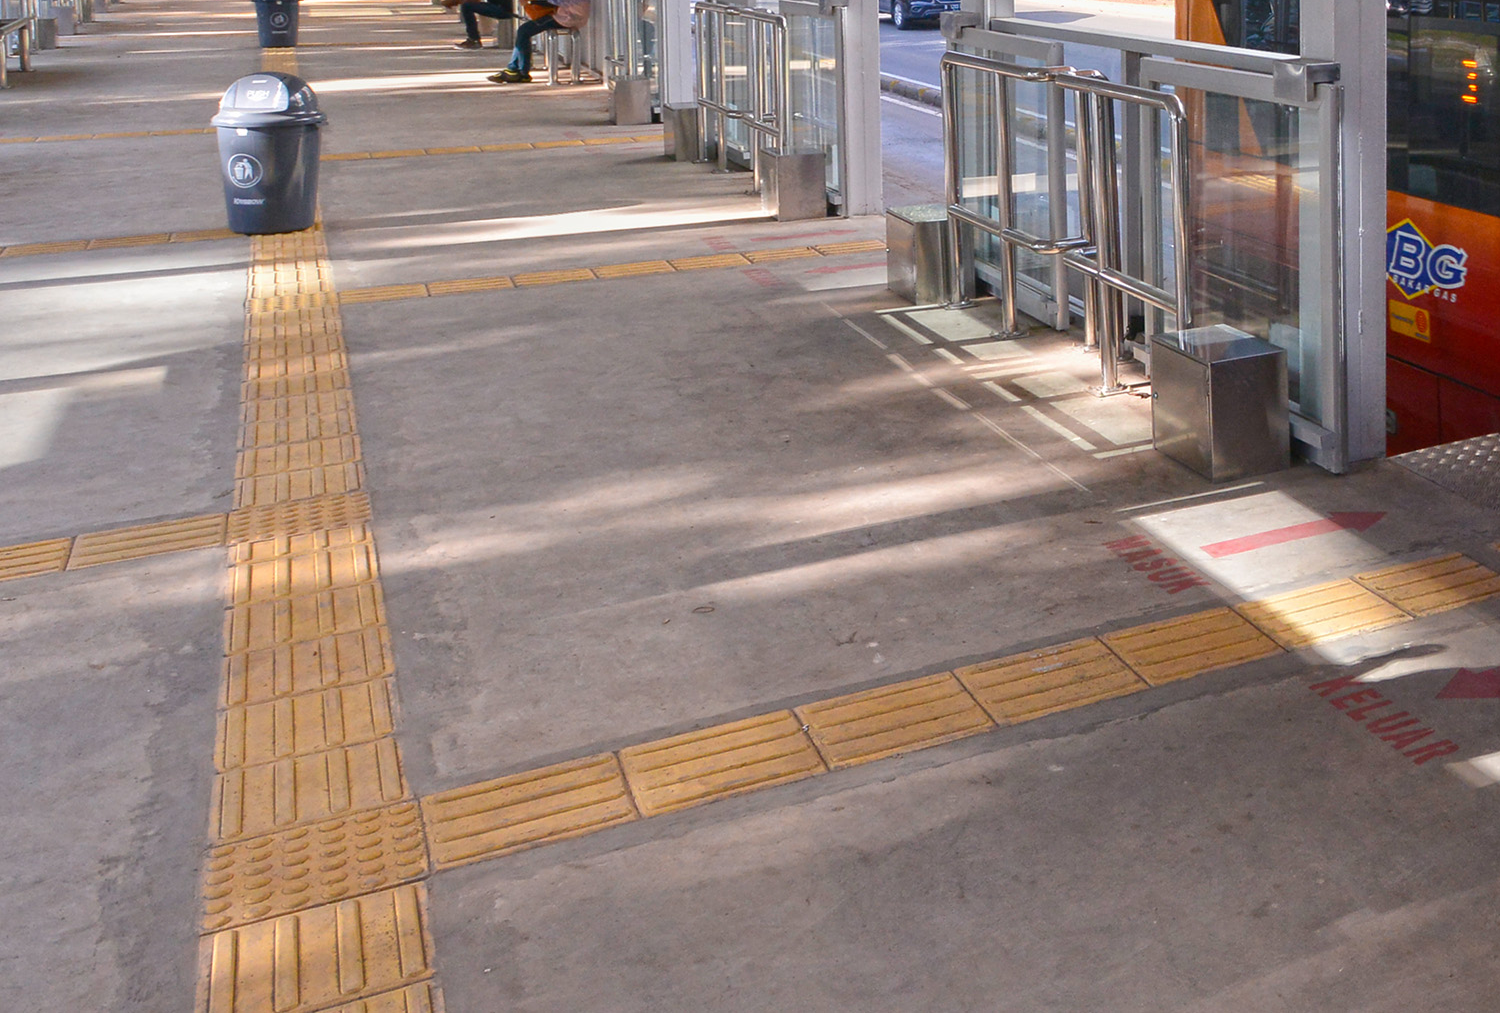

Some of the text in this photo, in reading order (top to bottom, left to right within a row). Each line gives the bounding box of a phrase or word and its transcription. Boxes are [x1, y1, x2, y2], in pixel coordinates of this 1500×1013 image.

[1433, 287, 1457, 303] GAS
[1101, 534, 1211, 595] MASUK
[1308, 674, 1460, 766] KELUAR
